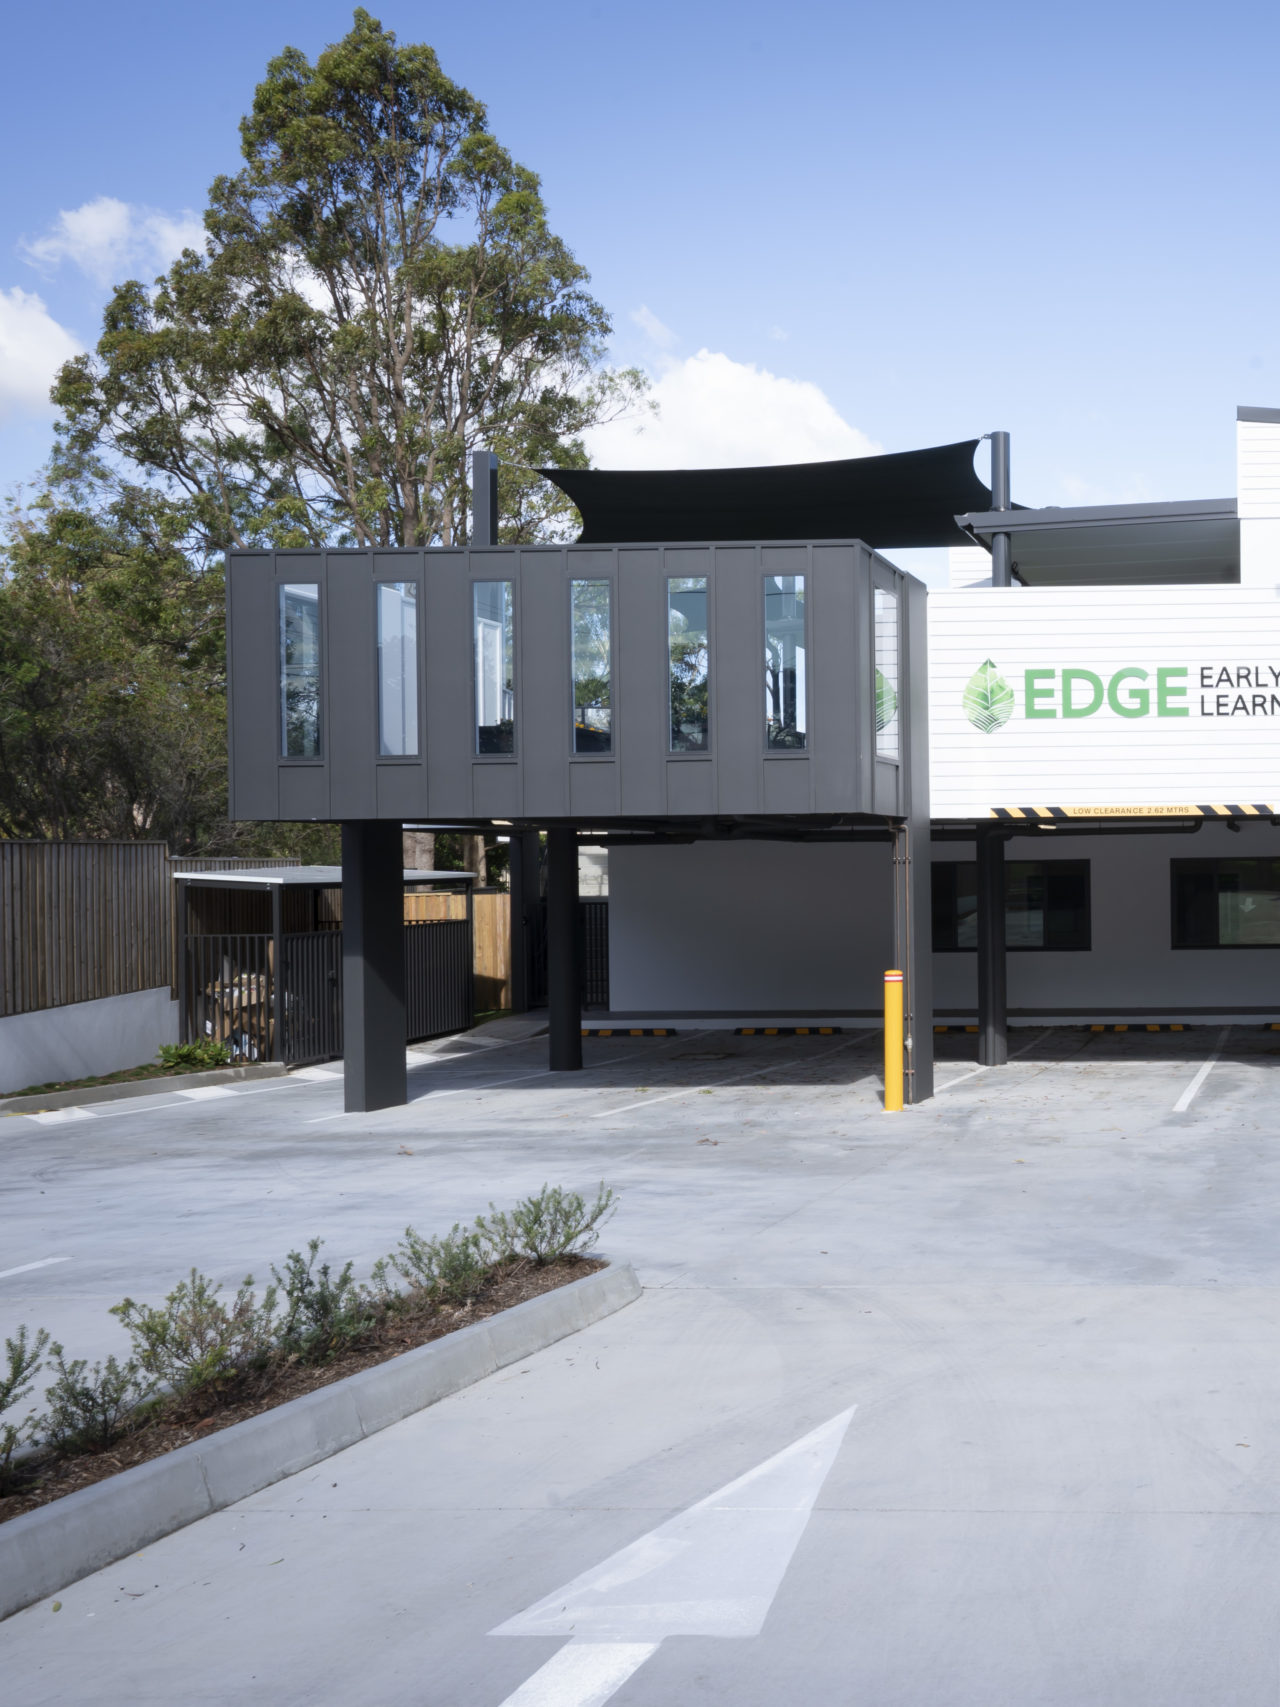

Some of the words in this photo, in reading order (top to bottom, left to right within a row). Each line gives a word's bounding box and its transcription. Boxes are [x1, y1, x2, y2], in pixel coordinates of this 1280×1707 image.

[1024, 667, 1190, 719] EDGE
[1073, 807, 1091, 815] LOW
[1093, 807, 1144, 815] CLEARANCE
[1147, 806, 1164, 814] 2.62
[1166, 806, 1190, 814] MTRS
